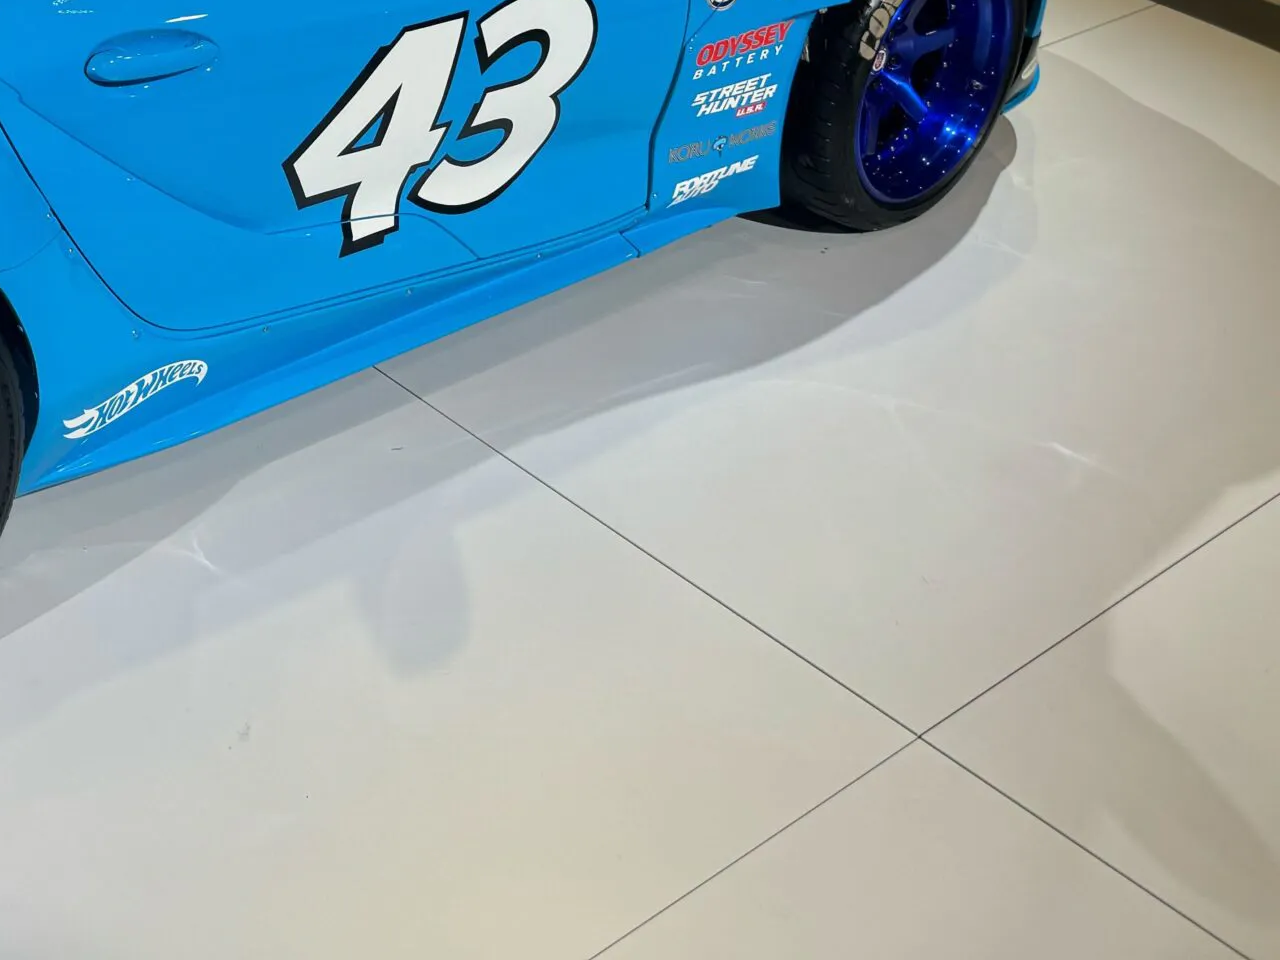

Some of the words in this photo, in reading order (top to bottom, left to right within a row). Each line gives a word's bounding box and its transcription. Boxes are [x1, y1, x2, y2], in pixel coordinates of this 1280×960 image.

[695, 19, 796, 68] ODYSSEY
[692, 44, 784, 81] BATTERY
[691, 72, 772, 107] STREET
[696, 84, 778, 118] HUNTER
[672, 154, 760, 199] FORTUNE
